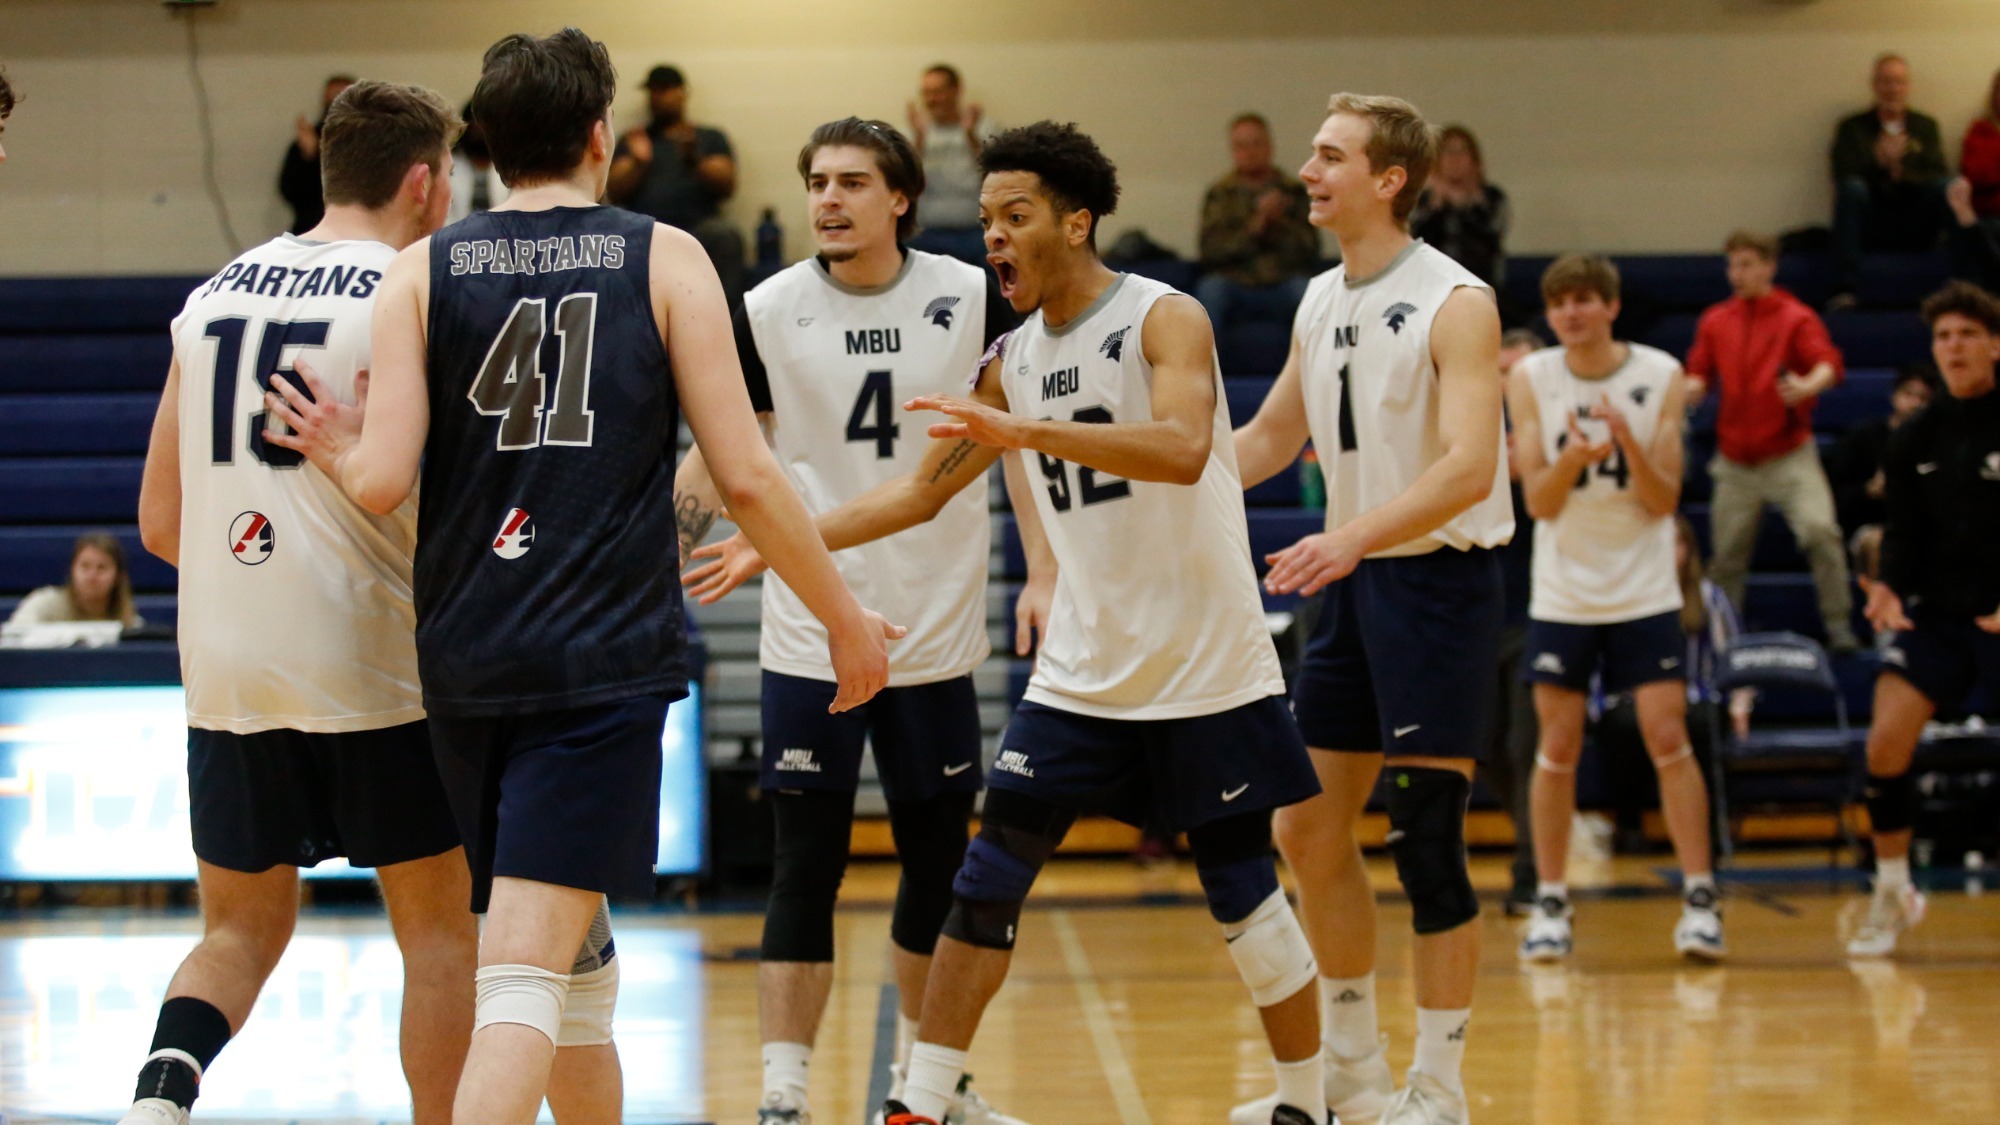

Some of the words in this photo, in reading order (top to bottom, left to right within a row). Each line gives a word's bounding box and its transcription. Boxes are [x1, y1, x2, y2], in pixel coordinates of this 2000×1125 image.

[451, 234, 626, 276] SPARTANS
[200, 263, 383, 300] SPARTANS
[845, 328, 902, 355] MBU
[1335, 325, 1360, 349] MU
[467, 292, 598, 451] 41
[1041, 366, 1080, 402] MBU
[201, 314, 335, 470] 15
[1338, 362, 1358, 453] 1
[845, 368, 900, 461] 4
[782, 748, 814, 763] MBU
[1001, 750, 1029, 766] MBU
